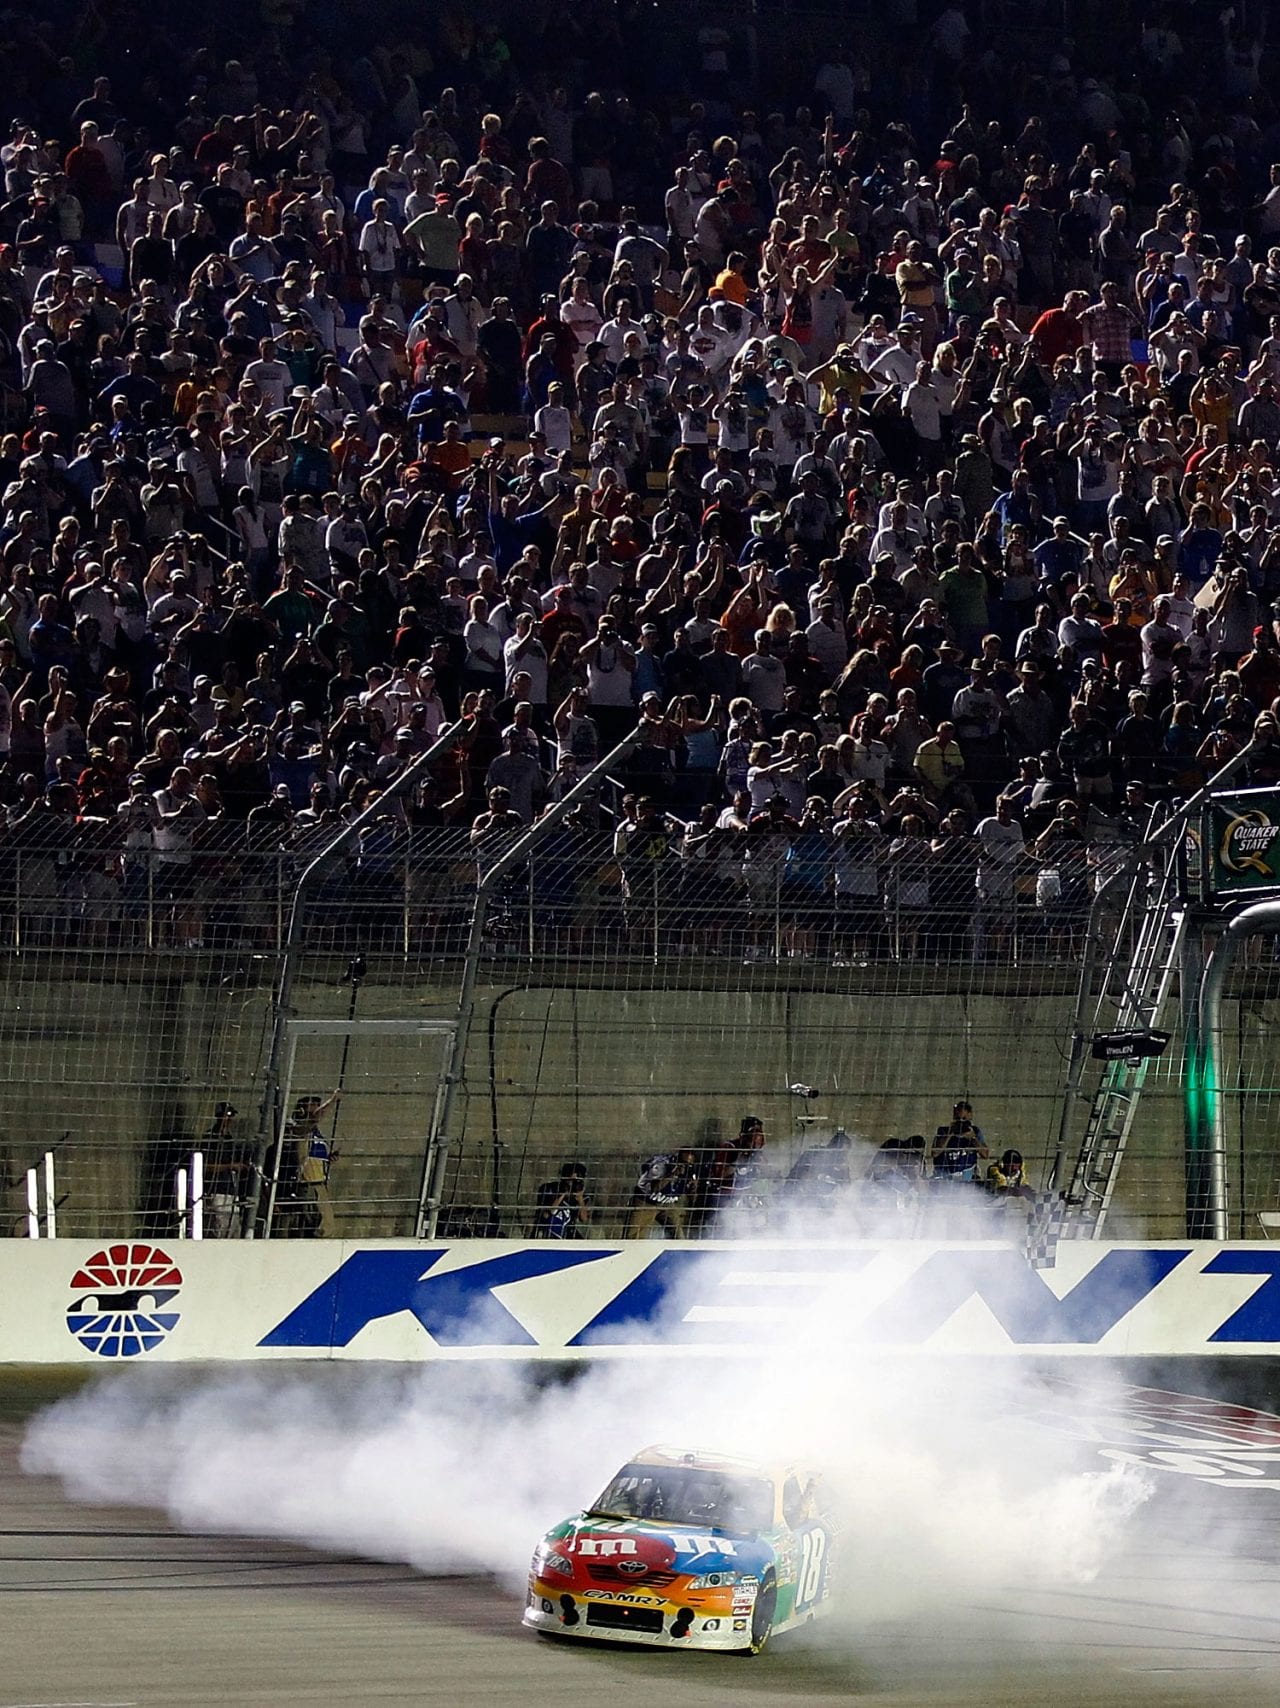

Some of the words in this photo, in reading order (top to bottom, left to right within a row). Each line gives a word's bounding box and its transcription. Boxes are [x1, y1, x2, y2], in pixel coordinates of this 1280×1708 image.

[1234, 826, 1279, 840] QUAKER
[1239, 838, 1271, 851] STATE
[795, 1528, 826, 1609] 18
[583, 1589, 669, 1606] CAMRY
